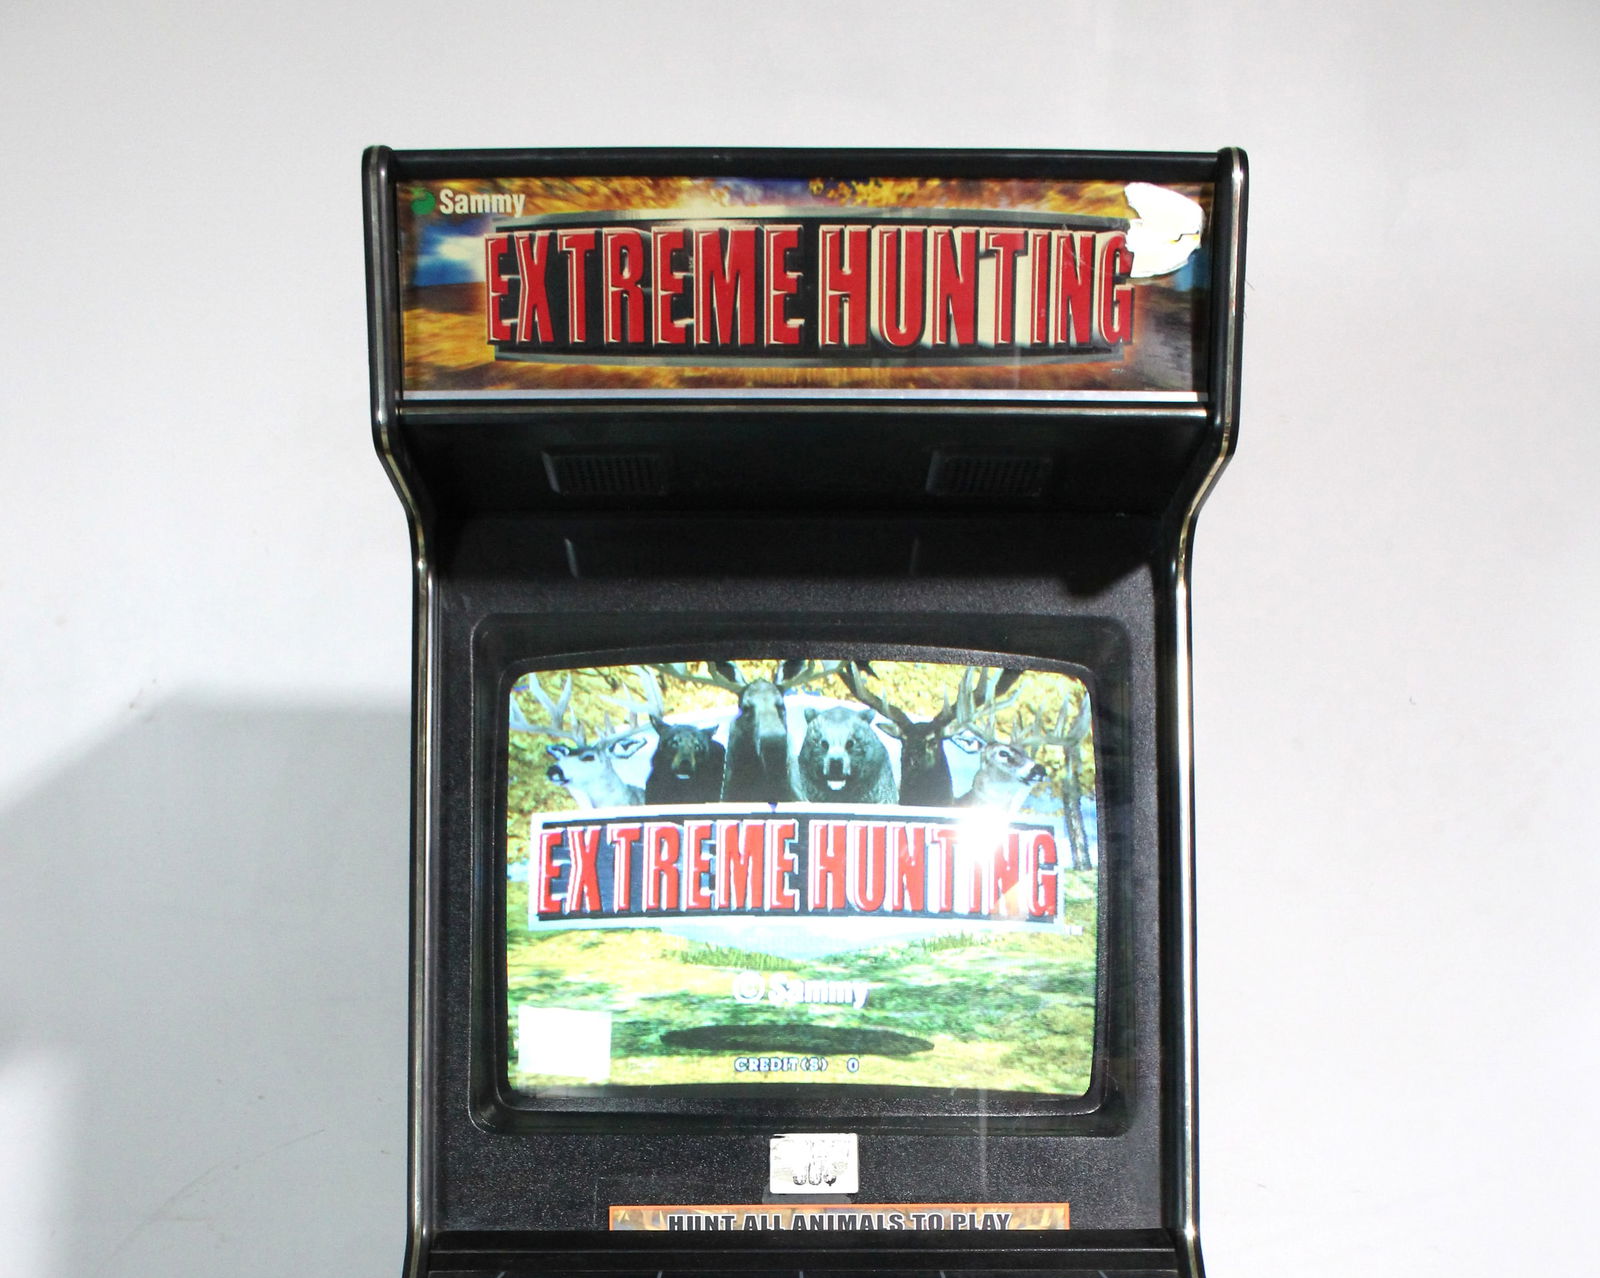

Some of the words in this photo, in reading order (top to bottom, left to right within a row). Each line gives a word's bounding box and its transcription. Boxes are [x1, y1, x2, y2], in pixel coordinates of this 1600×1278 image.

[439, 189, 525, 217] Sammy
[485, 224, 805, 348] EXTREME
[818, 224, 1135, 351] HUNTING
[537, 819, 799, 916] EXTREME
[808, 819, 1059, 918] HUNTING
[667, 1213, 736, 1230] HUNT
[790, 1212, 905, 1230] ANIMALS
[911, 1213, 945, 1230] TO
[951, 1212, 1012, 1230] PLAY
